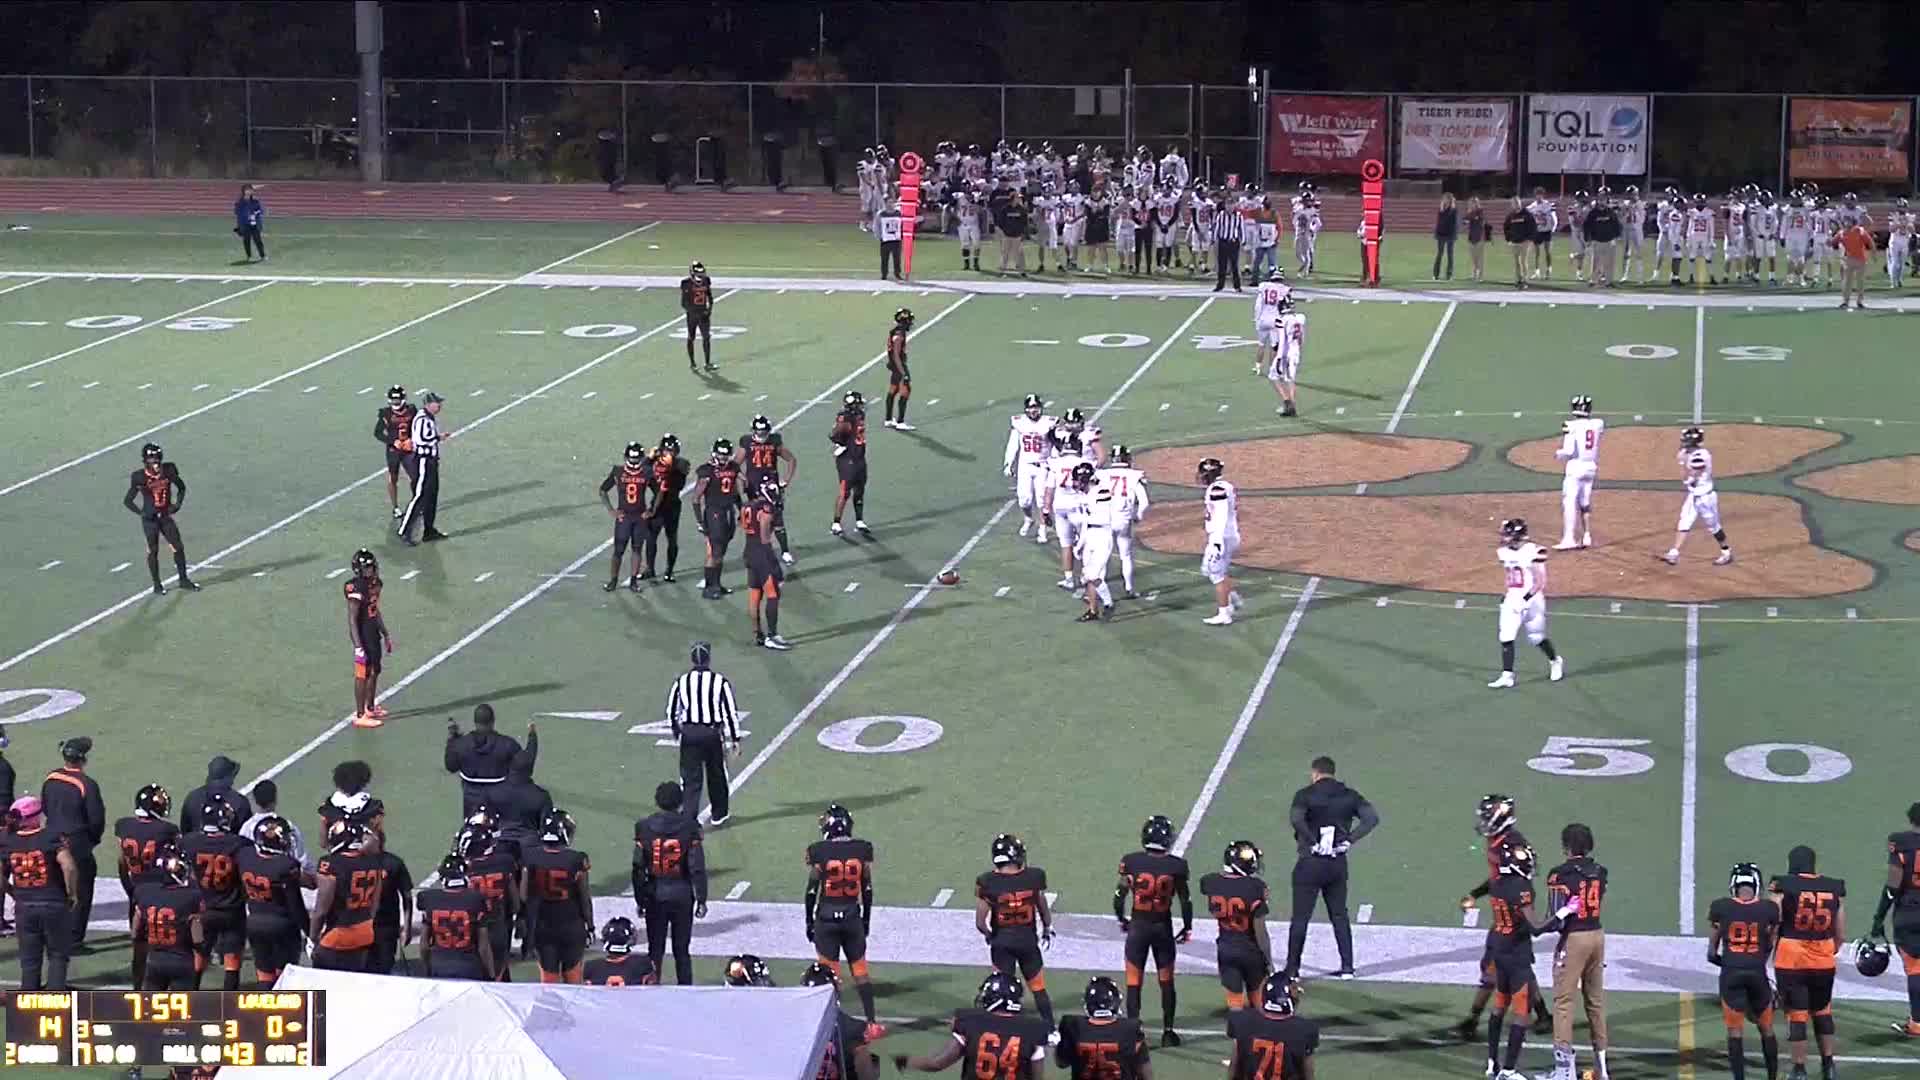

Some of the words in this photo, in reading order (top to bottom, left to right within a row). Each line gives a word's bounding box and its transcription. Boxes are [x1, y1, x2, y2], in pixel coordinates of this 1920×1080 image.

[1305, 113, 1331, 129] Jeff
[1533, 110, 1604, 138] TQL
[1537, 142, 1638, 153] FOUNDATION
[1585, 430, 1595, 449] 9
[626, 484, 639, 505] 8
[721, 477, 733, 494] 0
[1110, 476, 1128, 497] 71
[1576, 879, 1600, 920] 14
[1794, 892, 1834, 931] 65
[974, 1031, 1021, 1080] 64
[1252, 1038, 1285, 1080] 71
